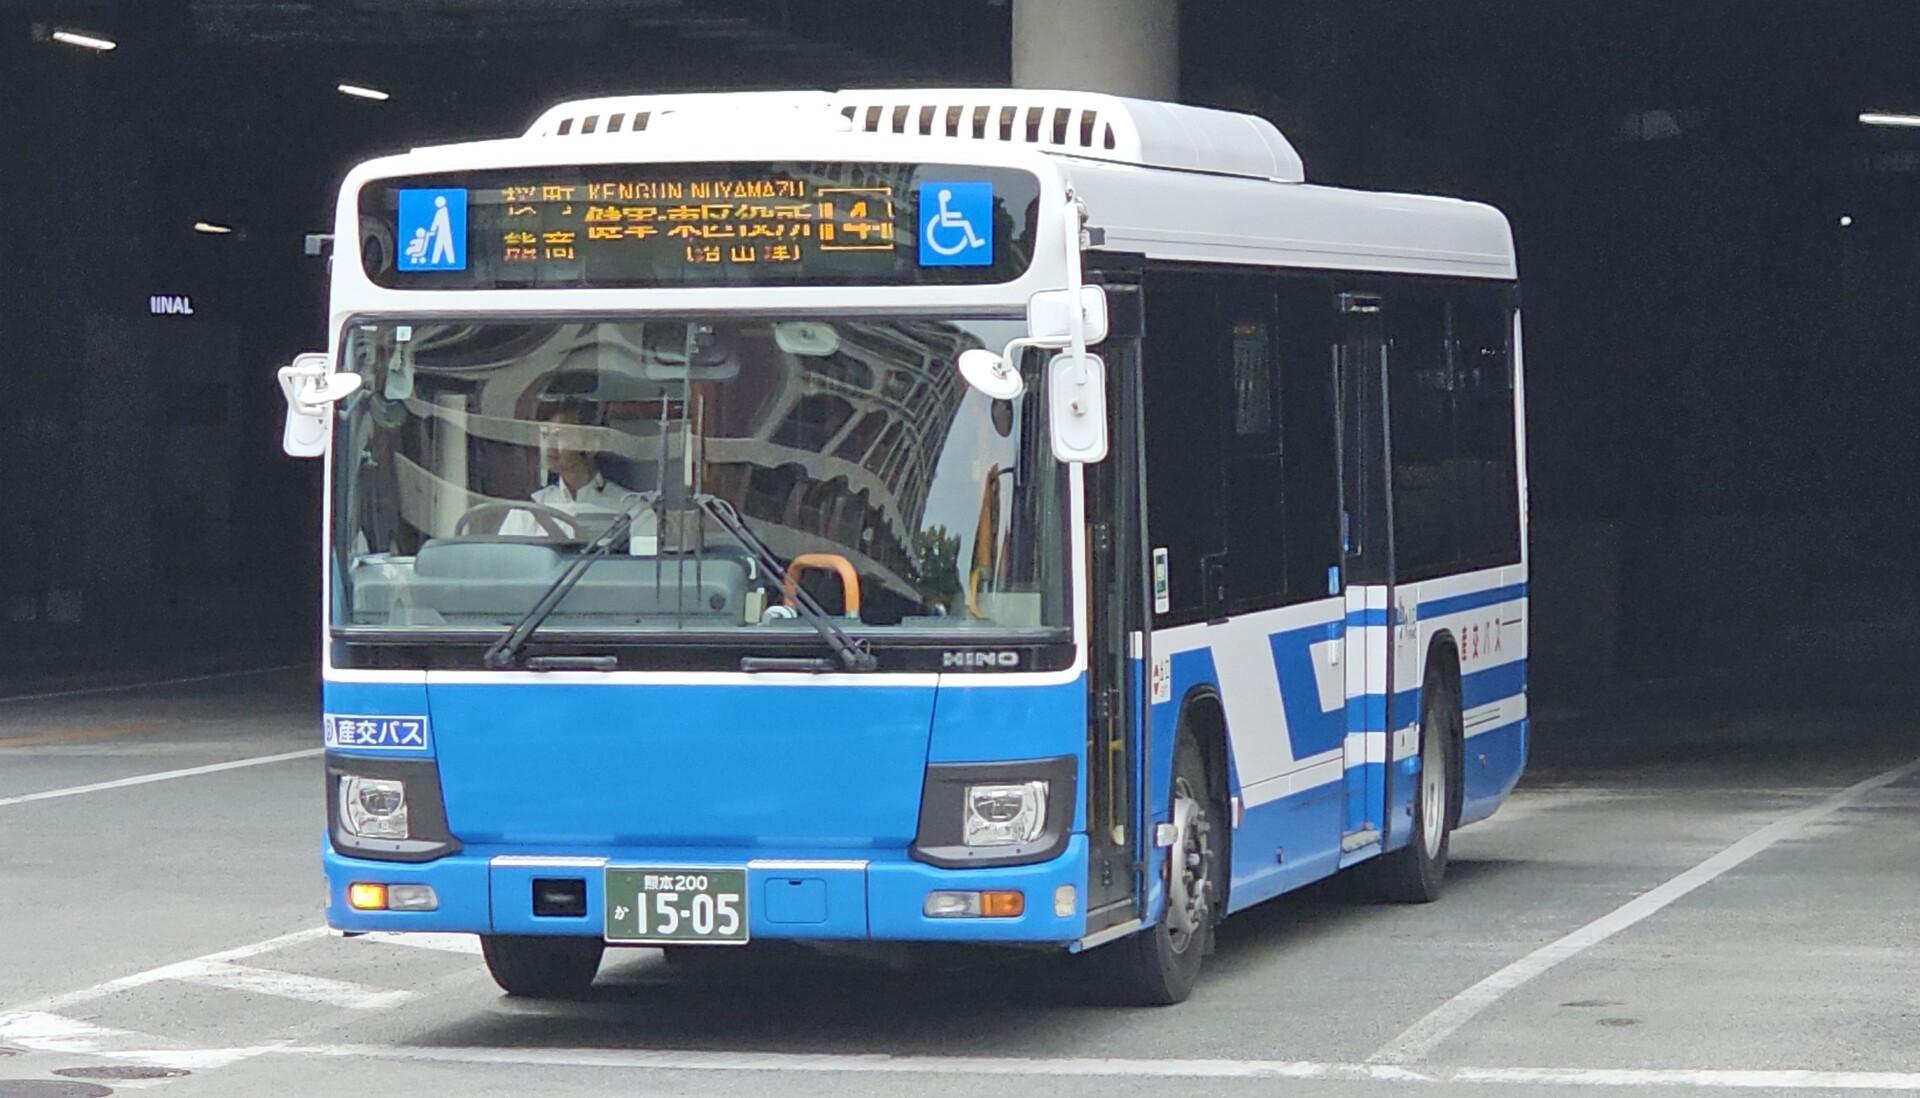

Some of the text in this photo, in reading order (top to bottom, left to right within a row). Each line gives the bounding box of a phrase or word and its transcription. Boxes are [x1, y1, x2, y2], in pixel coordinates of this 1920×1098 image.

[1461, 618, 1501, 661] 産交バス
[943, 652, 1018, 666] HINO
[338, 720, 422, 744] 産交バス
[614, 892, 739, 935] か 15-05
